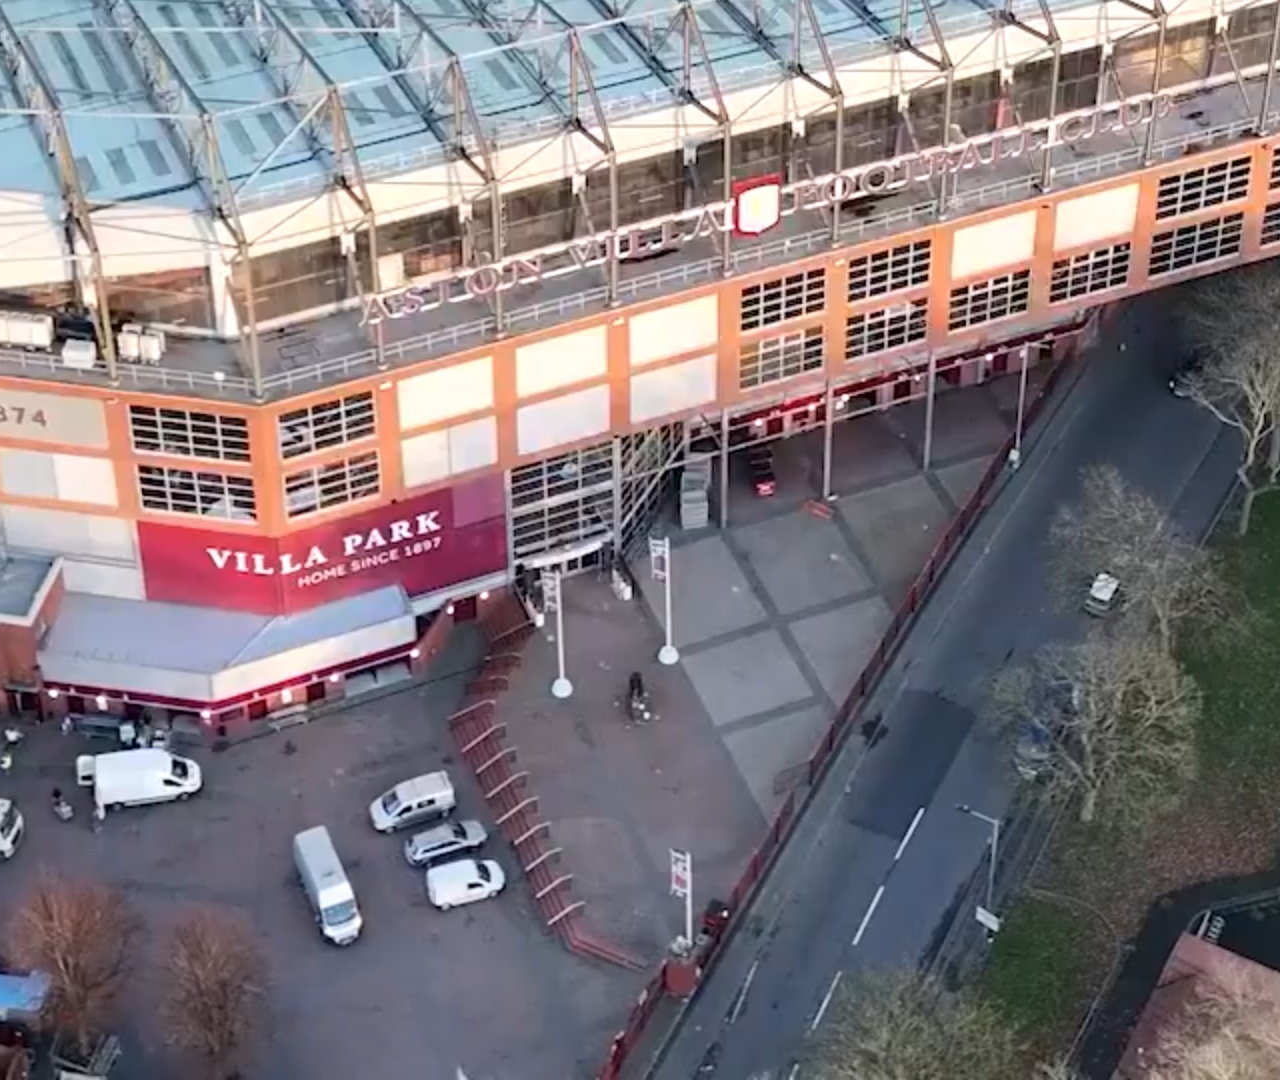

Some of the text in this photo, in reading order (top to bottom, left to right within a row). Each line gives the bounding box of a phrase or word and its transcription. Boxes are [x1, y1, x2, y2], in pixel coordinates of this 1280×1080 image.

[791, 91, 1172, 215] FOOTBALL CLUB
[359, 206, 727, 326] ASTON VILLA
[206, 510, 442, 576] VILLA PARK
[297, 536, 442, 588] HOME SINCE 1897
